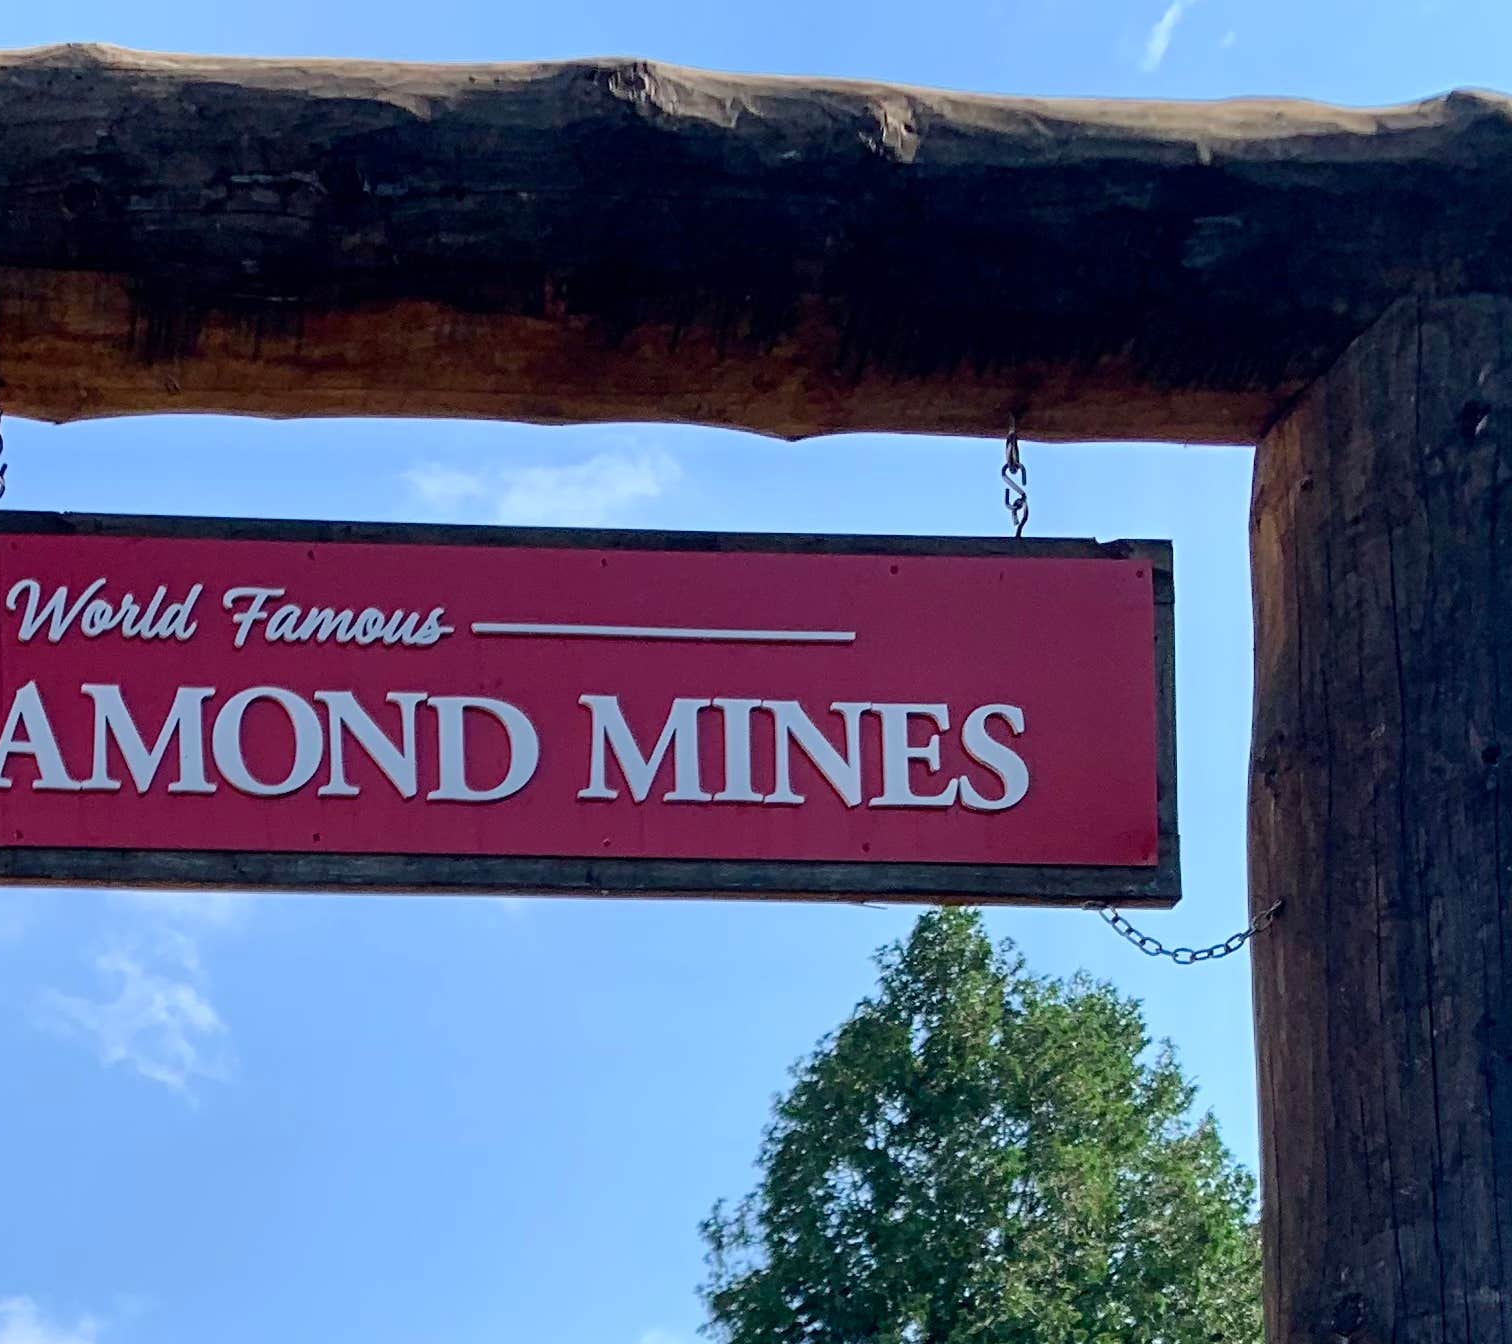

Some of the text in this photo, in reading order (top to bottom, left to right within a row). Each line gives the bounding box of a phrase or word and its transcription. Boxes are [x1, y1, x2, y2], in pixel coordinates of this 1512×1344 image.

[5, 576, 204, 645] World
[221, 585, 456, 649] Famous
[576, 693, 1031, 812] MINES
